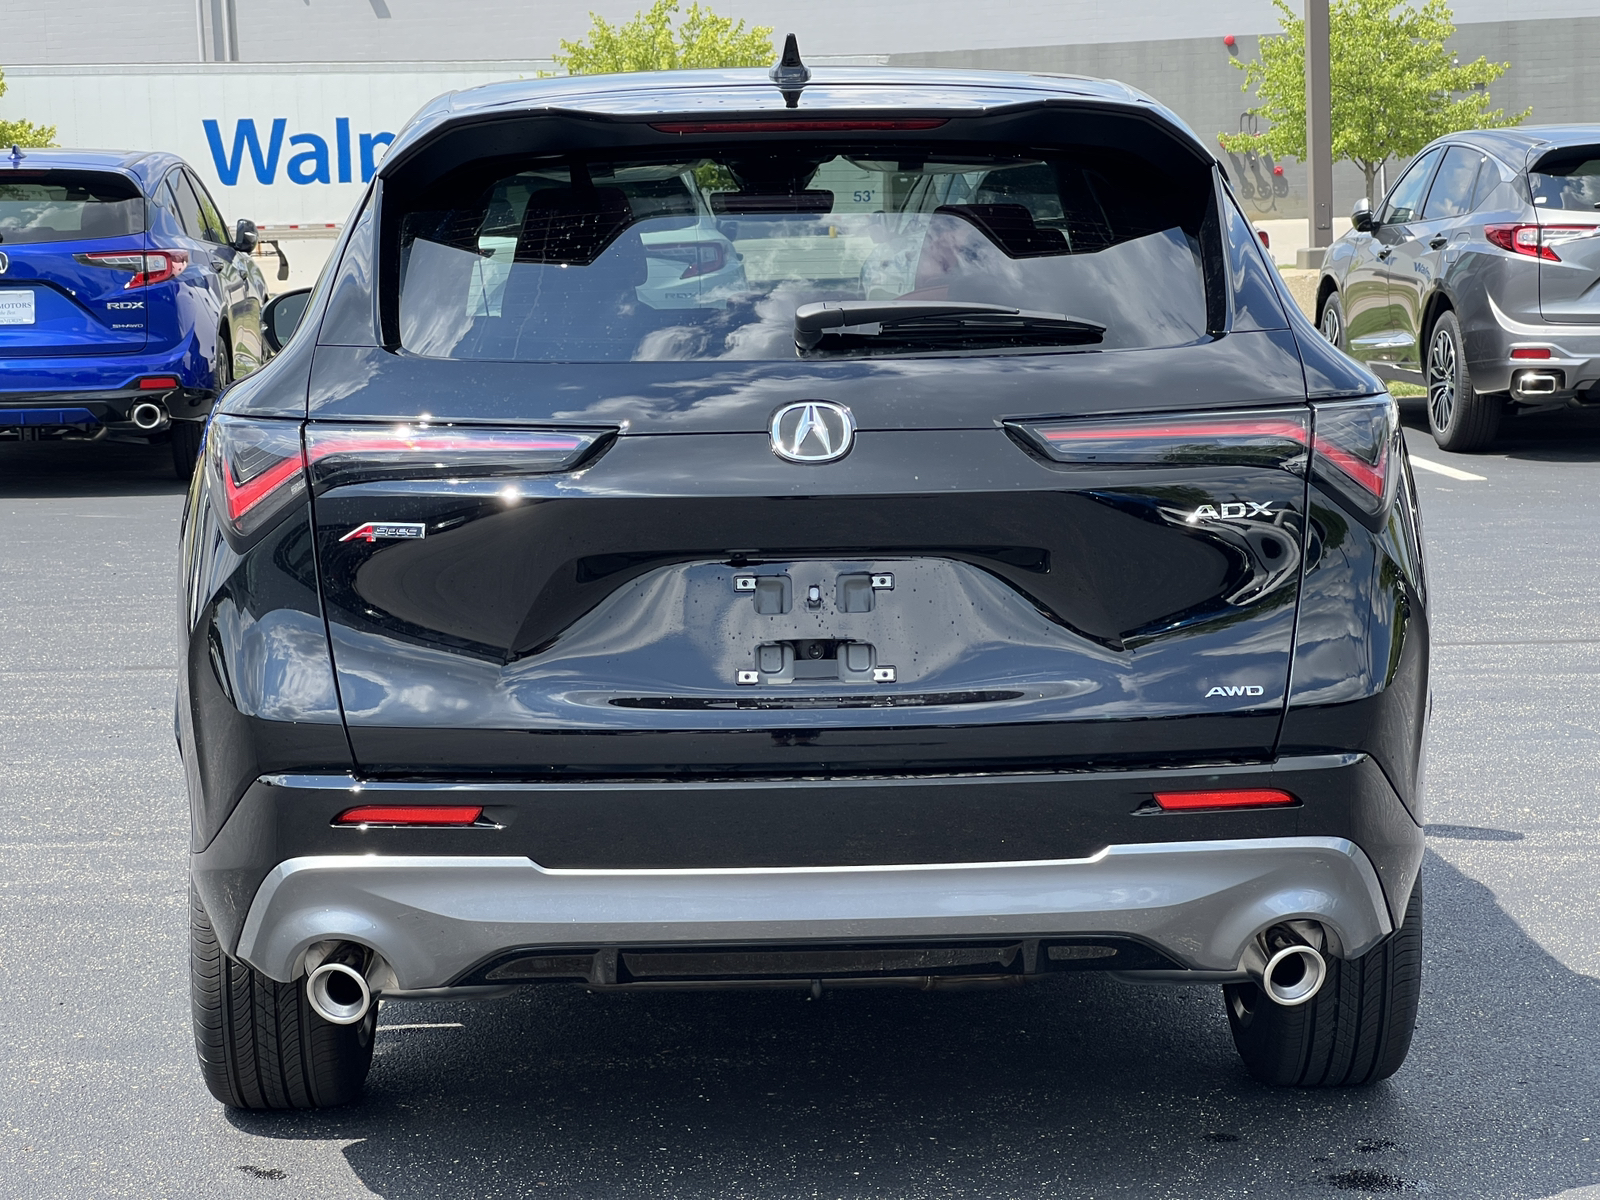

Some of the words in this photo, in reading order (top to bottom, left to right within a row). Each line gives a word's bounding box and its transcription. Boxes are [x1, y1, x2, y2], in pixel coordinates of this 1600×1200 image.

[106, 301, 145, 310] RDX
[1186, 500, 1274, 522] ADX
[1204, 685, 1264, 698] AWD
